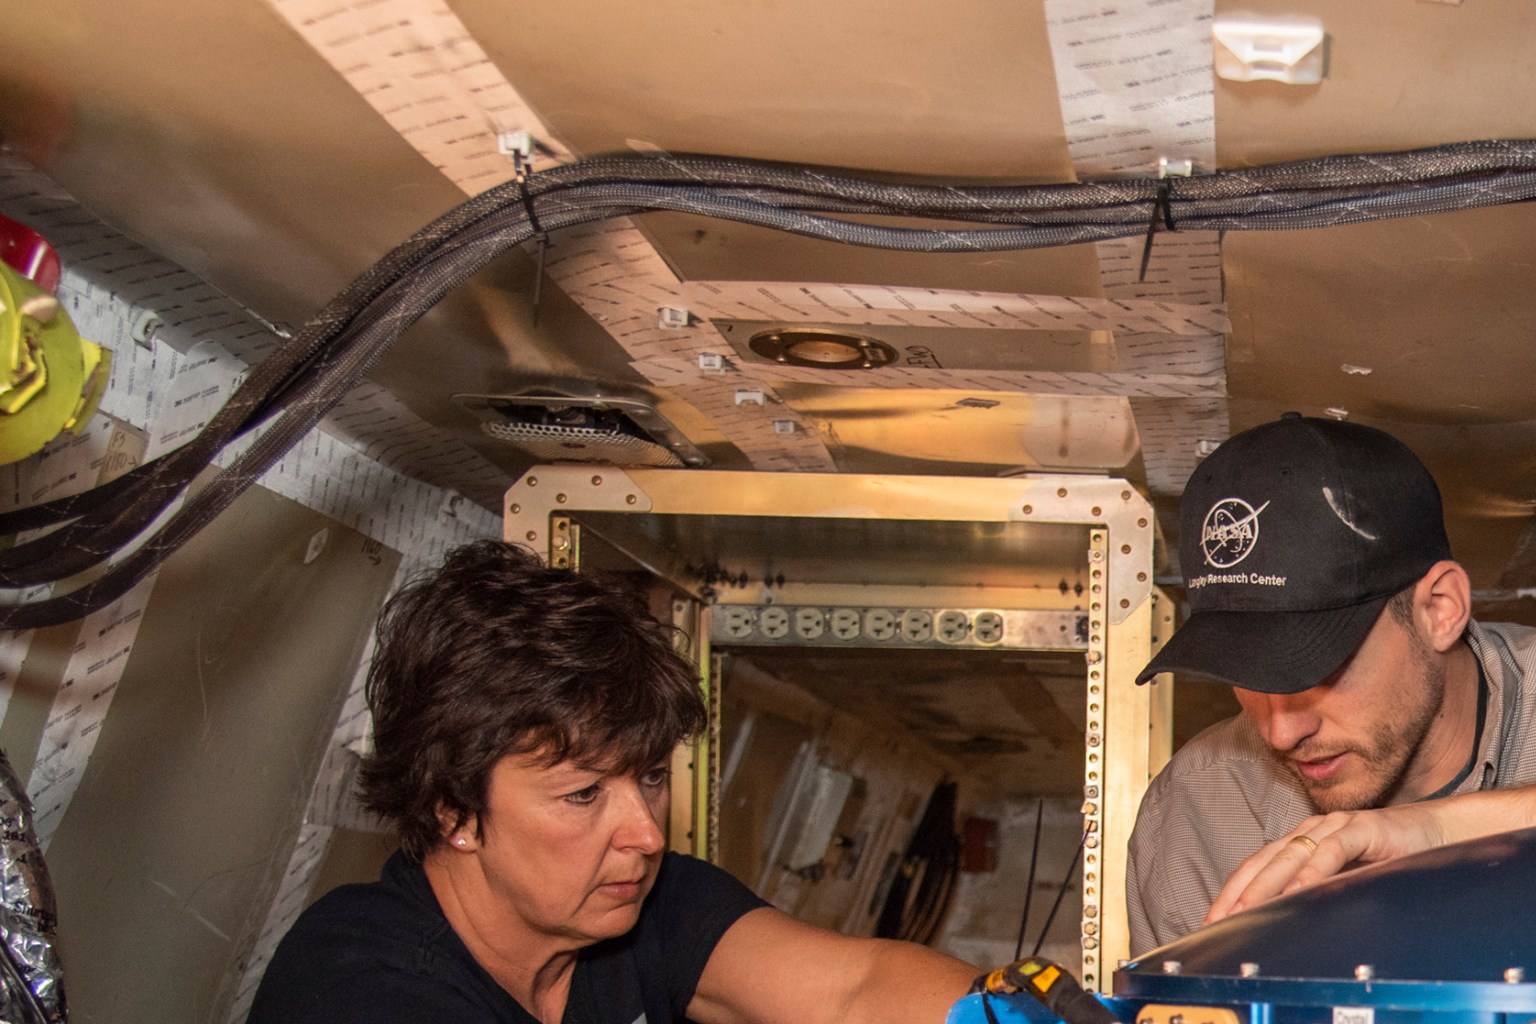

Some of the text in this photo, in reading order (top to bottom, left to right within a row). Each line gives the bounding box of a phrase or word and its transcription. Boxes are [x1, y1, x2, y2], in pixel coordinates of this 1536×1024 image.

[1206, 523, 1254, 541] NASA
[1207, 573, 1248, 585] Research
[1250, 573, 1287, 586] Center
